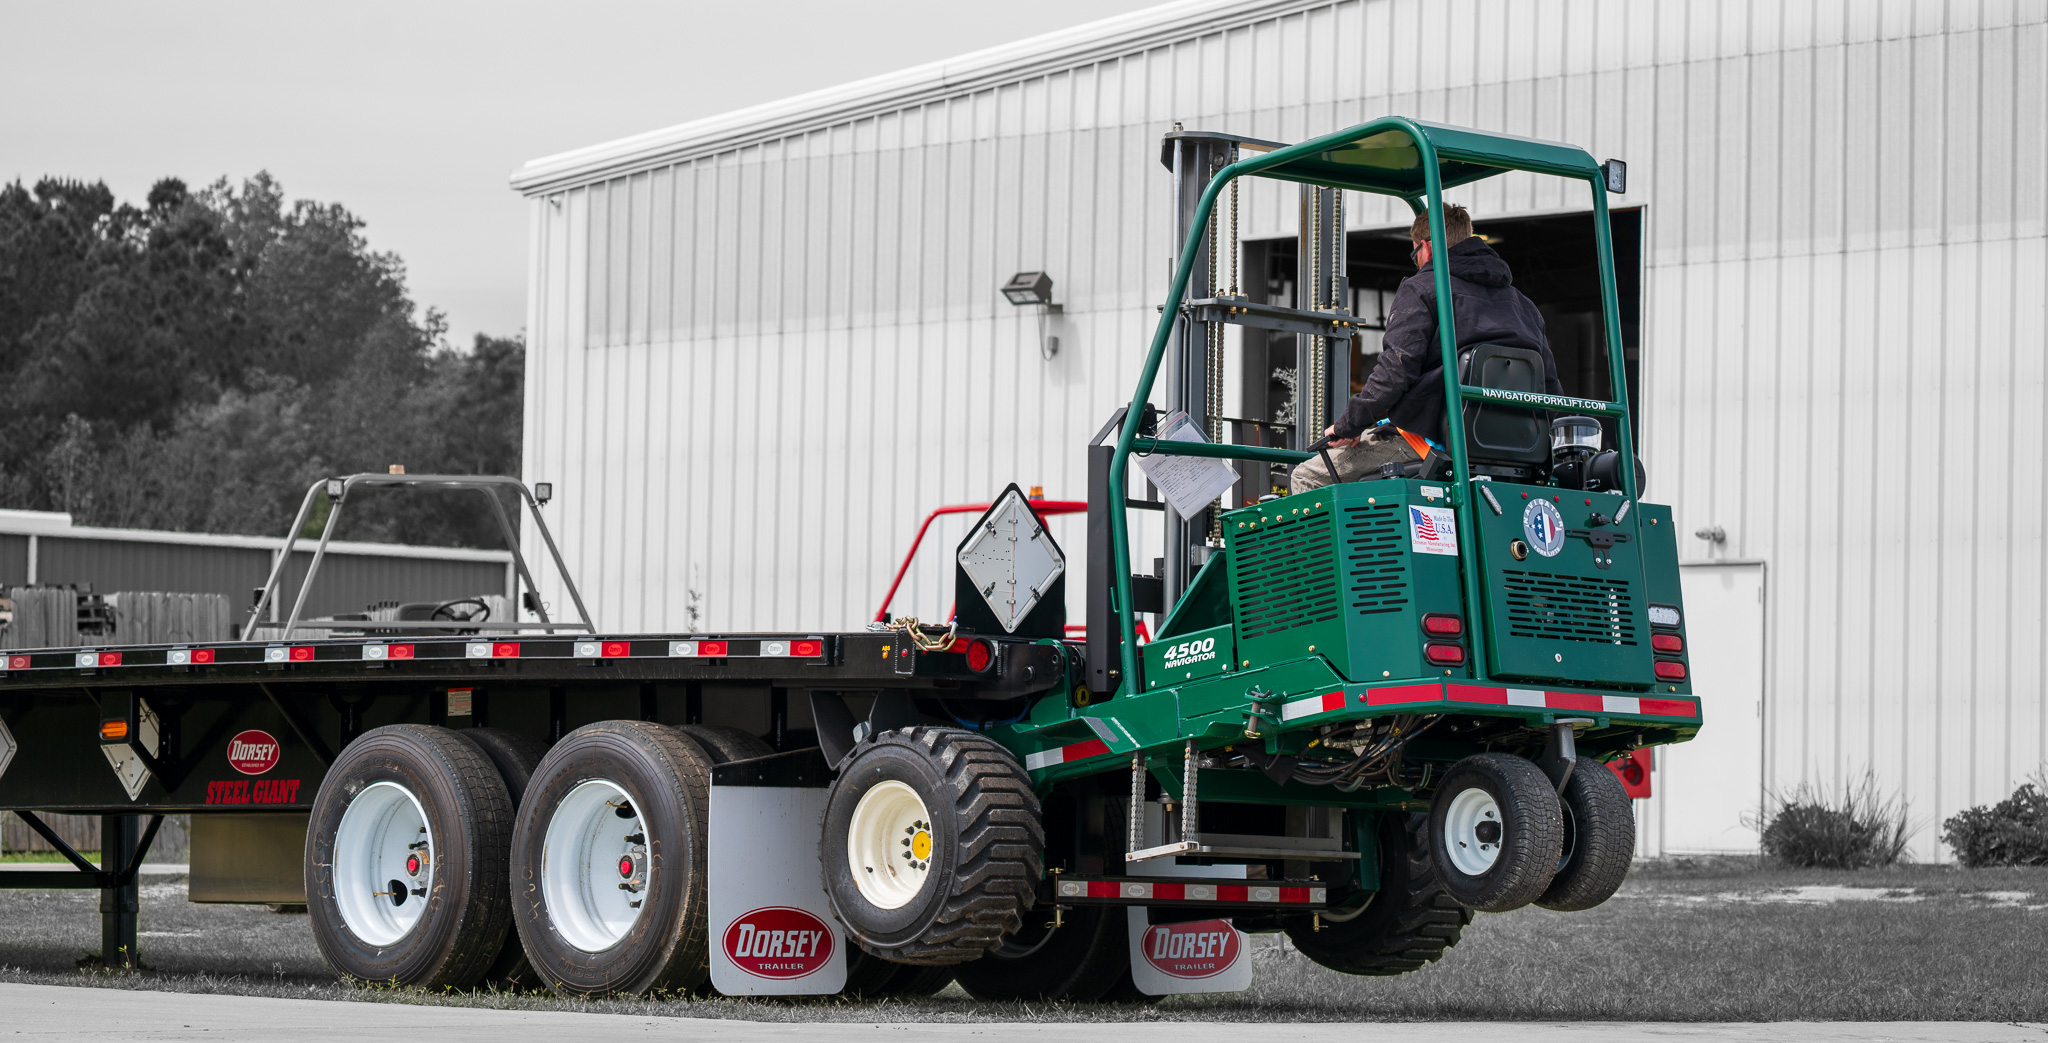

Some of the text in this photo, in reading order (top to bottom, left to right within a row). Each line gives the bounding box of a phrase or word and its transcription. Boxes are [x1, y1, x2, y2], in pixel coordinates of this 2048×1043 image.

[1481, 388, 1607, 411] NAVIGATORFORKLIFT.COM
[1523, 499, 1564, 528] NAVIGATOR
[1163, 637, 1215, 661] 4500
[1164, 651, 1216, 670] NAVIGATOR
[230, 740, 276, 761] DORSEY
[205, 779, 300, 805] STEEL GIANT
[735, 923, 824, 958] DORSEY
[1153, 927, 1230, 960] DORSEY
[1173, 963, 1216, 971] TRAILER
